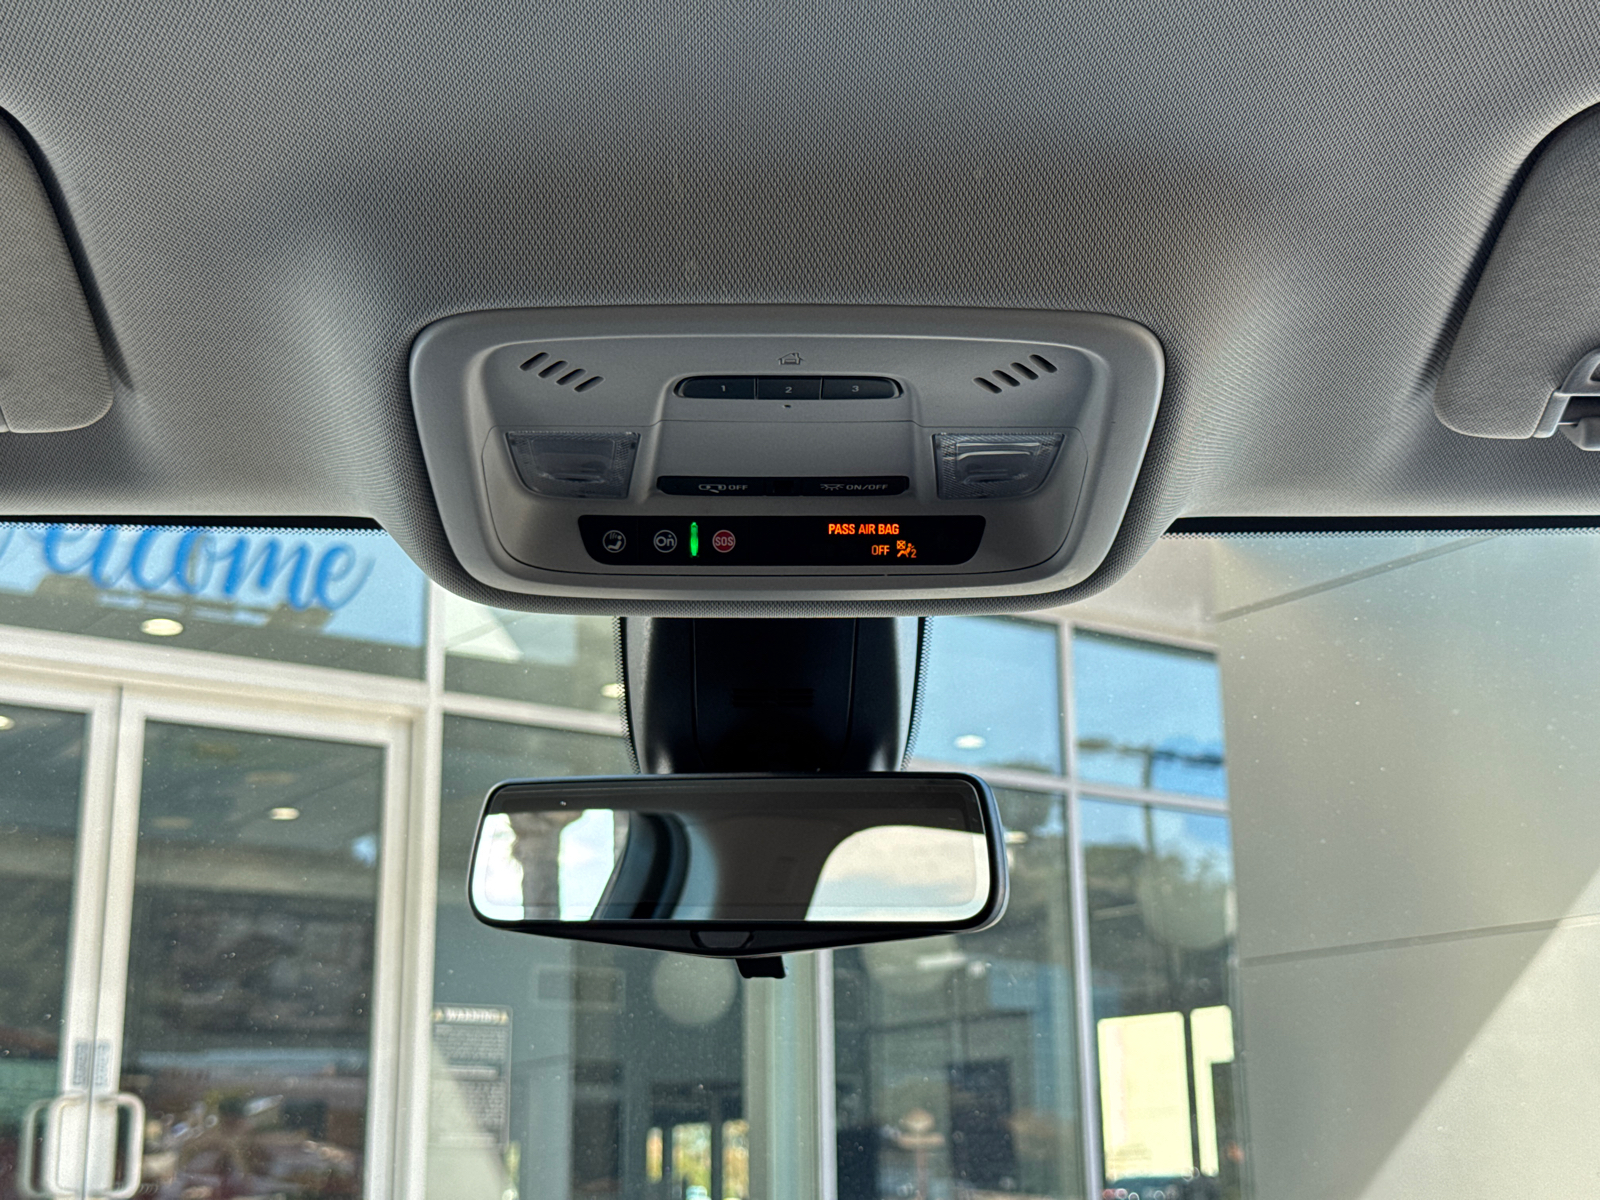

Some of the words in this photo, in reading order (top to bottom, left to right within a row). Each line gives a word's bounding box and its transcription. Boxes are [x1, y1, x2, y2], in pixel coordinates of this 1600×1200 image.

[785, 386, 792, 394] 2
[852, 385, 859, 393] 3
[828, 523, 856, 535] PASS
[858, 523, 876, 535] AIR
[877, 523, 900, 535] BAG
[715, 536, 734, 547] SOS
[871, 544, 890, 556] OFF
[0, 525, 376, 611] elcome
